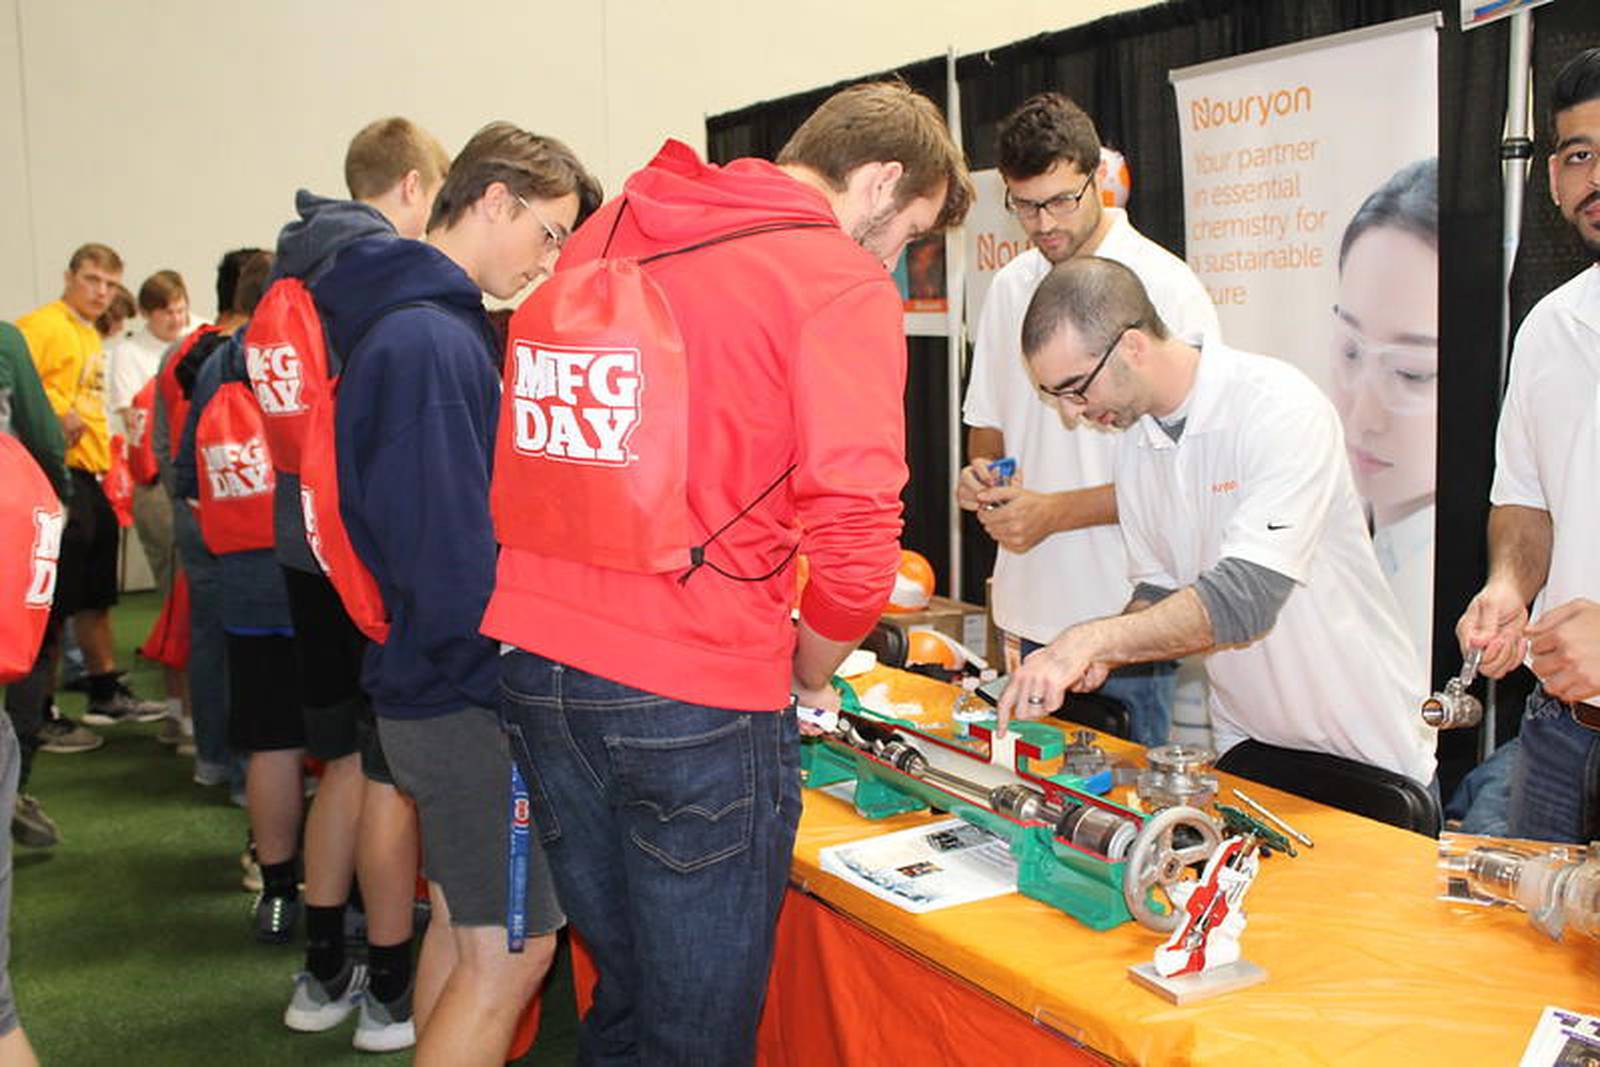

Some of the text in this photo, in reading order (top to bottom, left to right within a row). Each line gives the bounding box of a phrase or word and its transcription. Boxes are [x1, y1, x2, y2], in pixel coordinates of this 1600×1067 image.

[1192, 86, 1312, 131] Nouryon
[1238, 140, 1319, 172] partner
[1211, 174, 1300, 206] essential
[1191, 206, 1328, 241] chemistry for
[1204, 244, 1323, 272] sustainable
[515, 346, 639, 408] MFG
[515, 399, 639, 460] DAY
[206, 438, 268, 472] MFG
[209, 463, 268, 497] DAY
